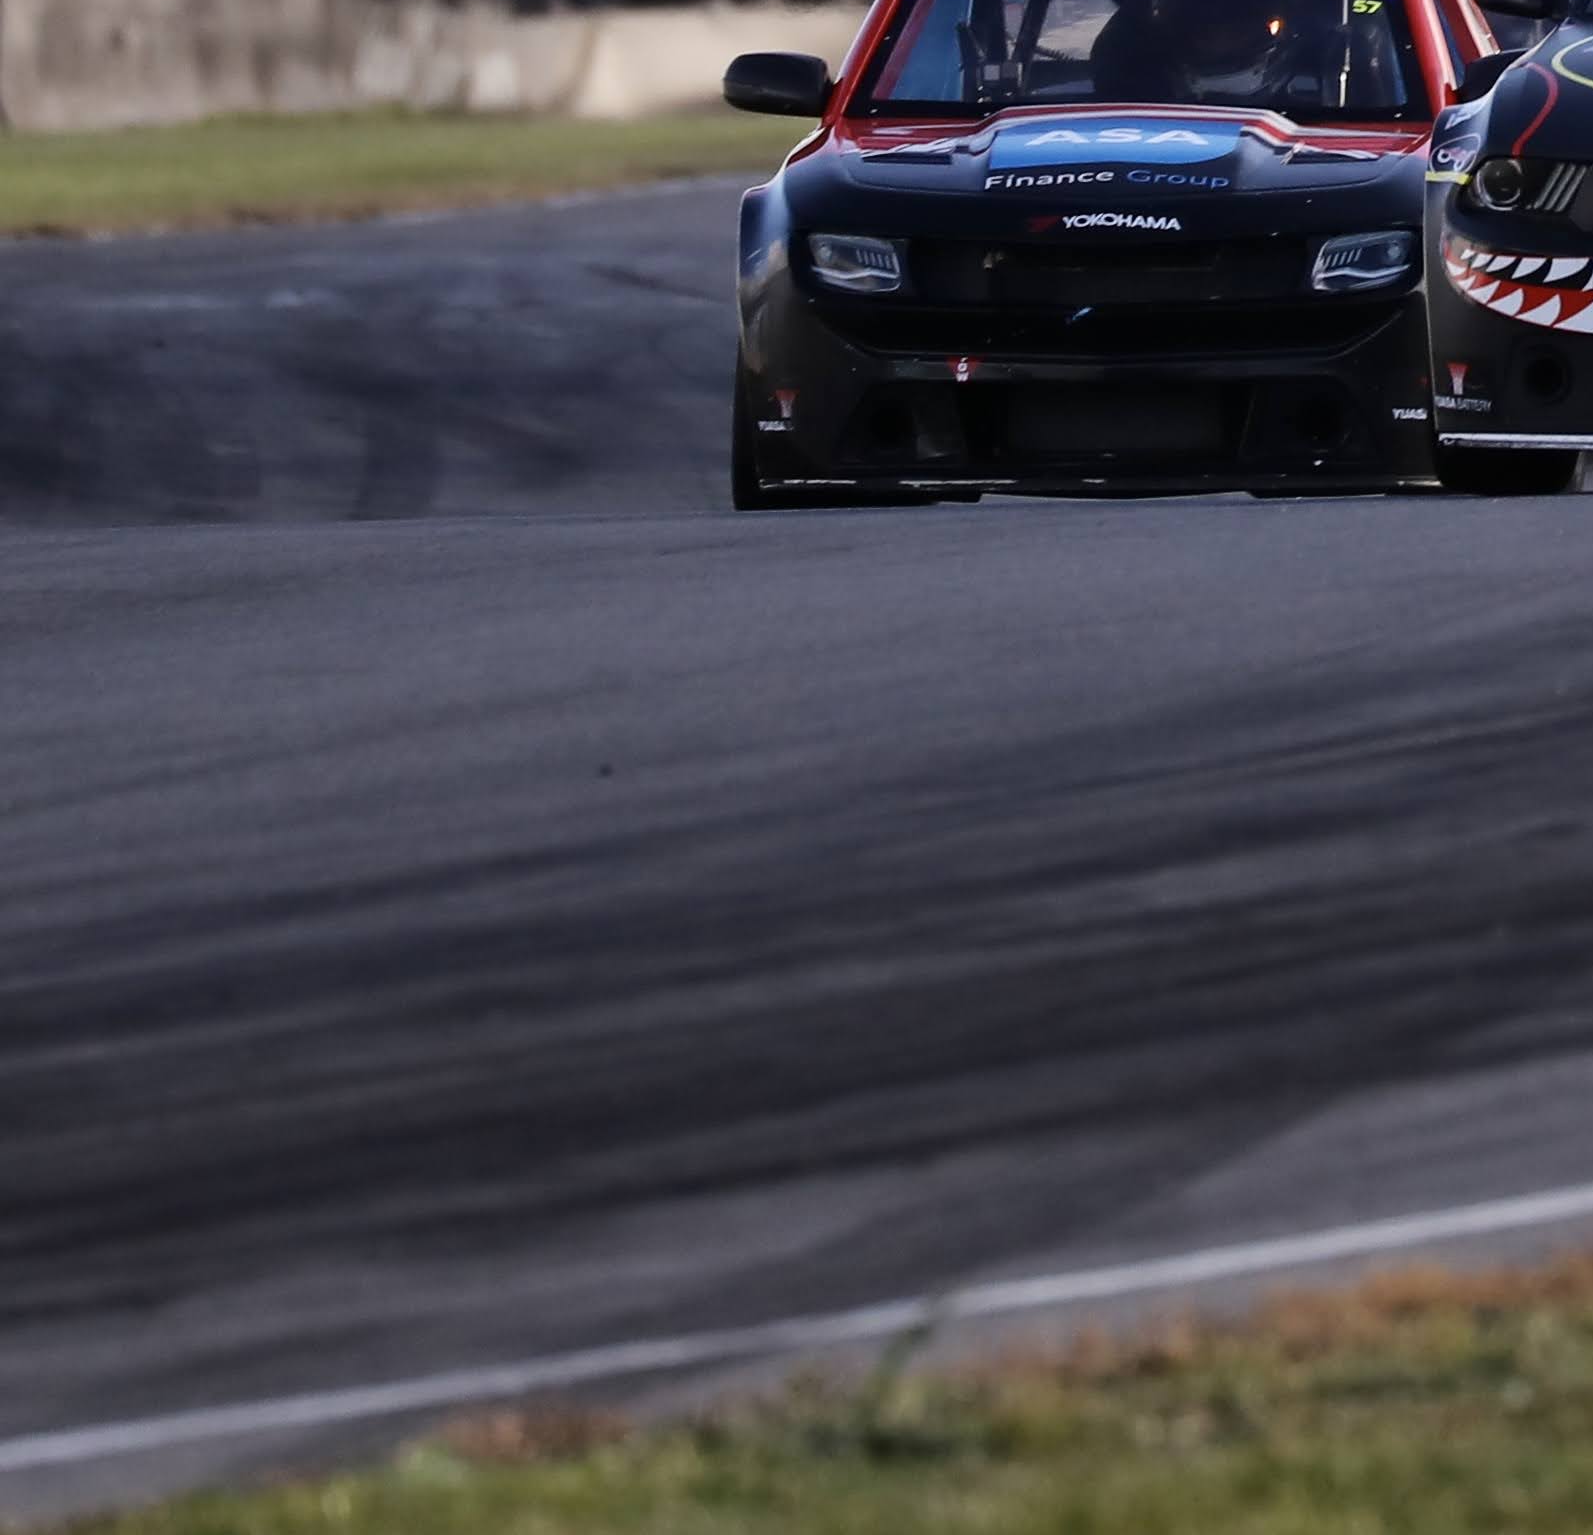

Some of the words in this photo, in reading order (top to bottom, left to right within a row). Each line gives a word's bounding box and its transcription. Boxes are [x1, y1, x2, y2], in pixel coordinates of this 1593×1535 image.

[1352, 0, 1382, 14] 57
[1024, 127, 1209, 146] ASA
[984, 170, 1115, 190] Finance
[1127, 169, 1230, 190] Group
[1062, 213, 1182, 231] YOKOHAMA
